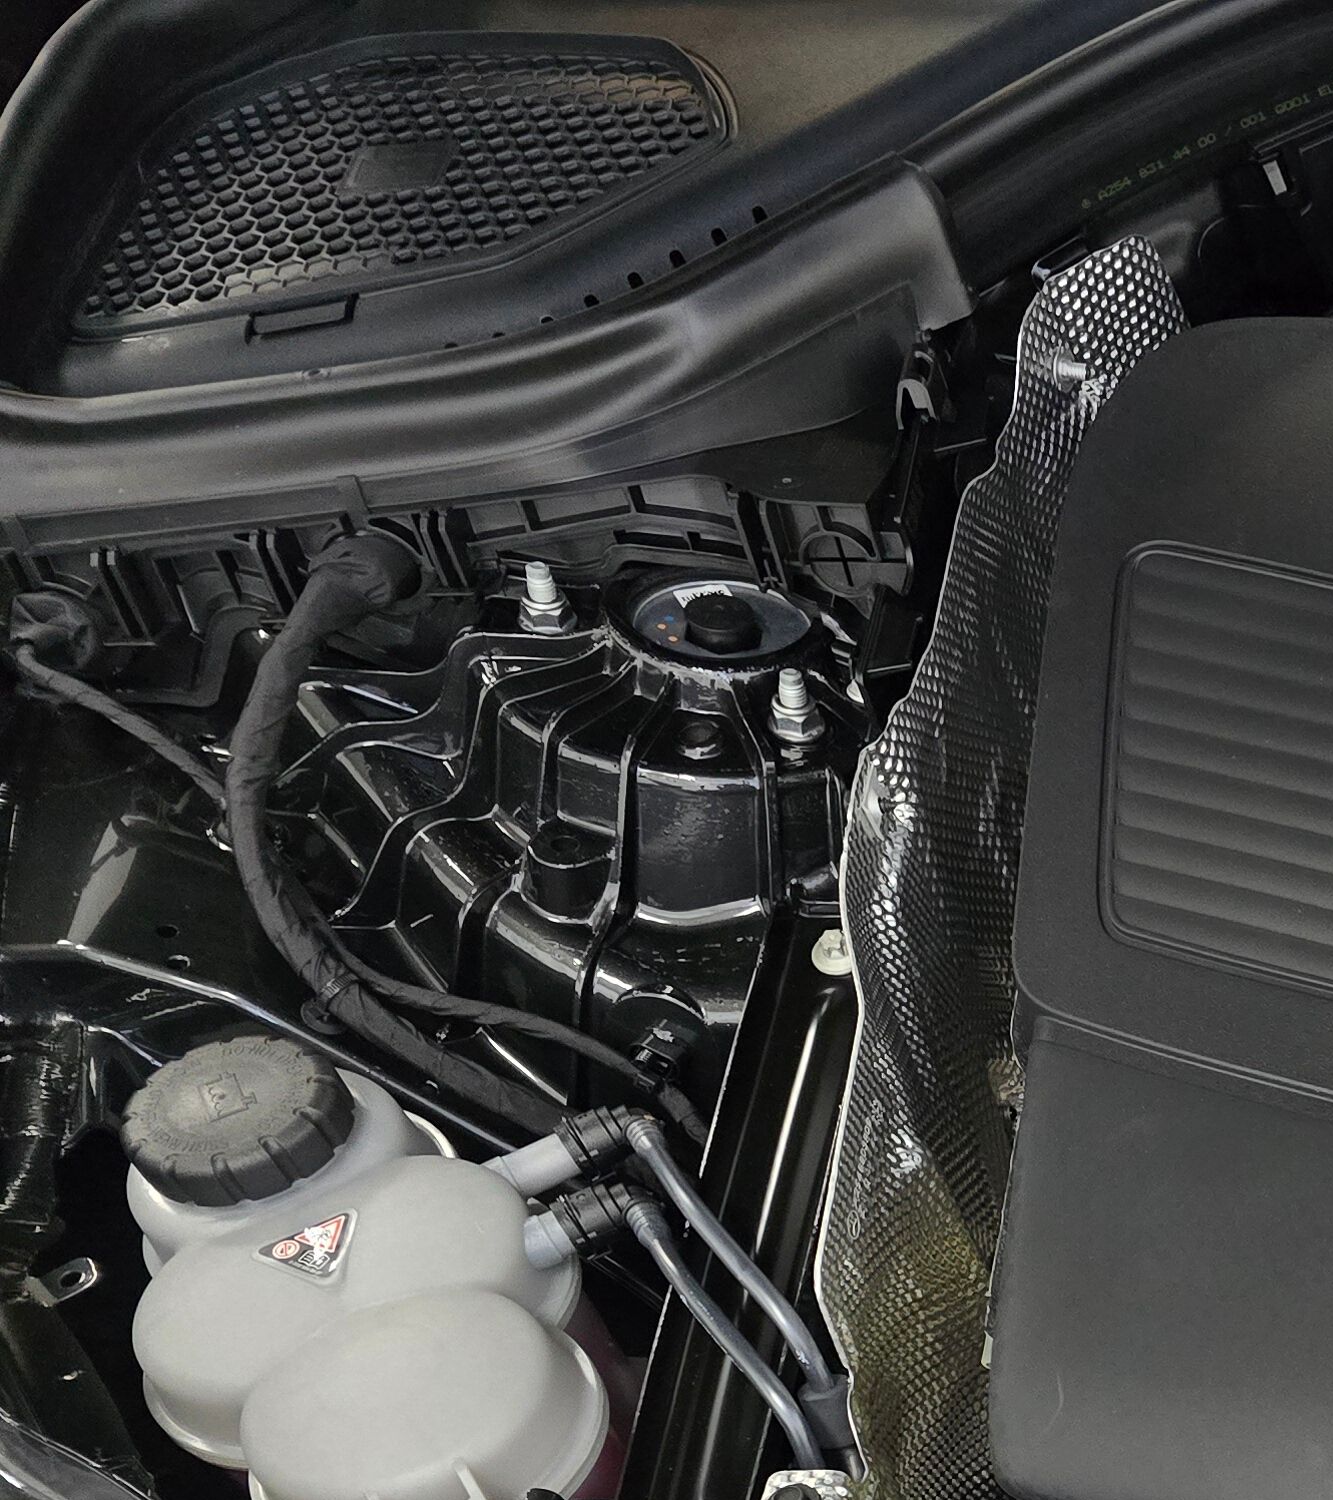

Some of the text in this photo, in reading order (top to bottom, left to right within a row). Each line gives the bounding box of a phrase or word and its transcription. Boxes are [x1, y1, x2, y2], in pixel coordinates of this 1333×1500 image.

[1097, 176, 1133, 200] A254
[1172, 146, 1191, 160] 44
[1197, 132, 1217, 149] 00
[1240, 111, 1267, 129] 001
